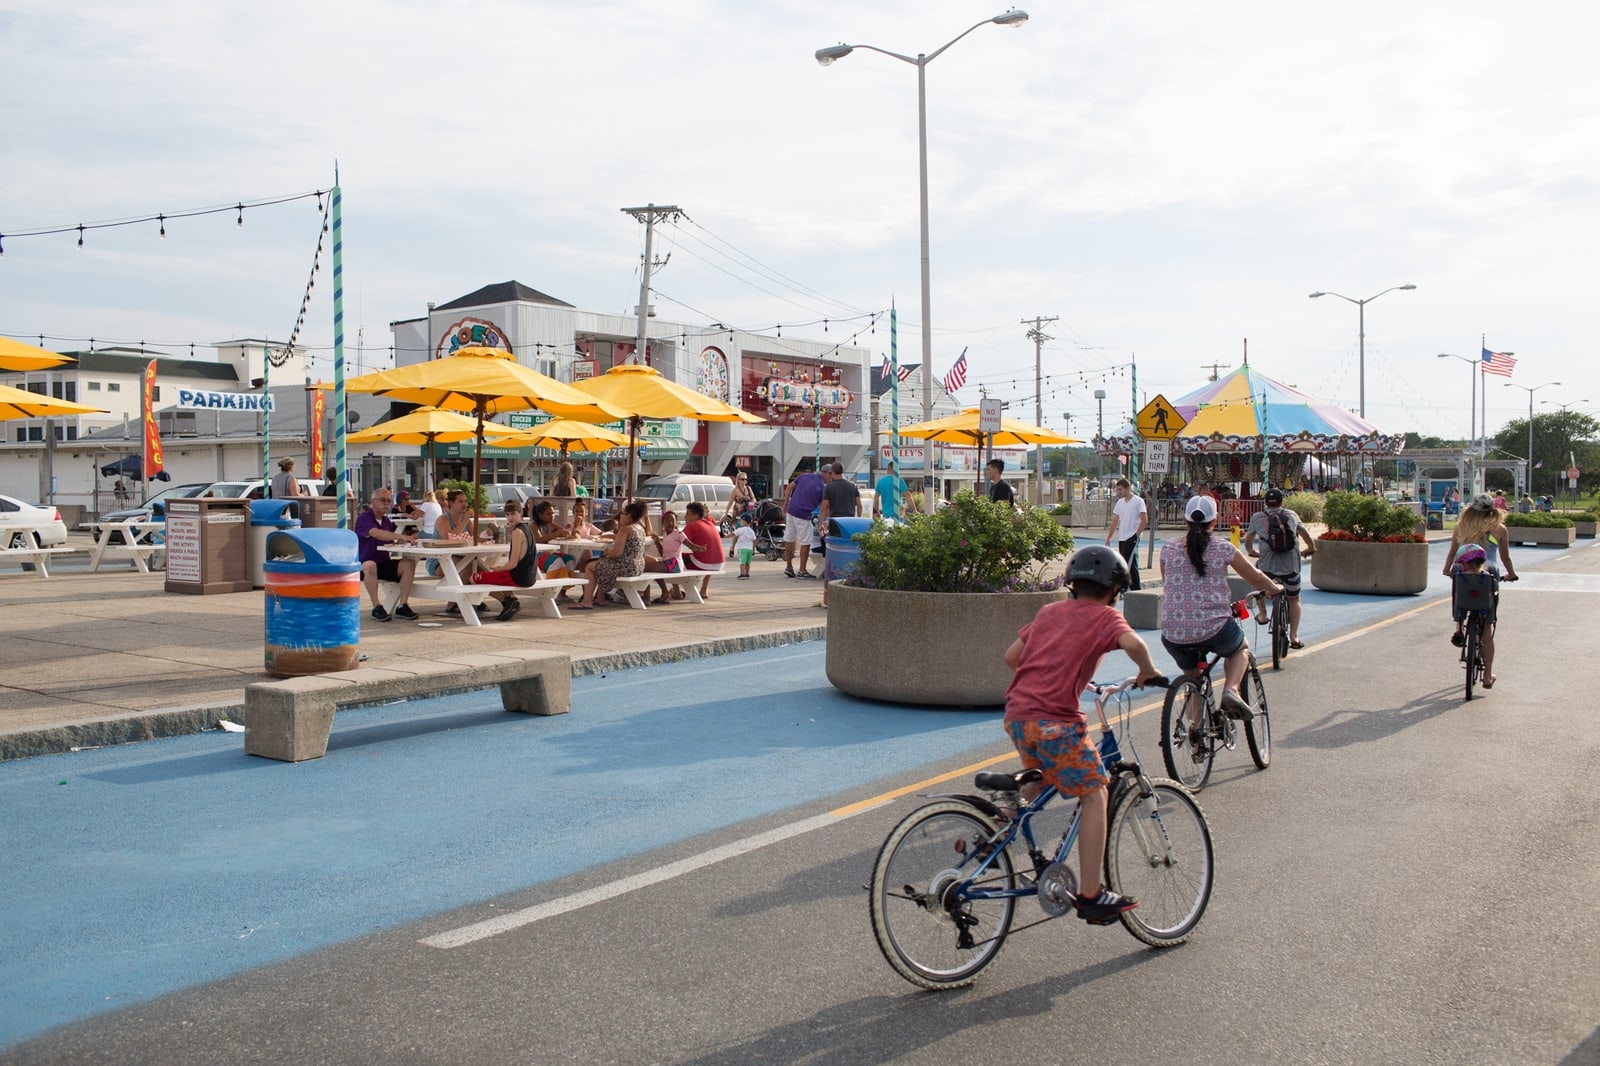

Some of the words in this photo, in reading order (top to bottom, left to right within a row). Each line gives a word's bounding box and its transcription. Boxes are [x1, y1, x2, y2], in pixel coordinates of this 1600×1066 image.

[449, 325, 499, 353] JOE'S
[179, 390, 273, 410] PARKING
[985, 408, 996, 416] NO
[511, 415, 532, 423] CHICKEN
[1153, 443, 1163, 451] NO
[532, 447, 571, 458] JILLYS
[883, 448, 923, 457] WILEY'S
[735, 456, 750, 466] ATM
[1149, 462, 1165, 470] TURN
